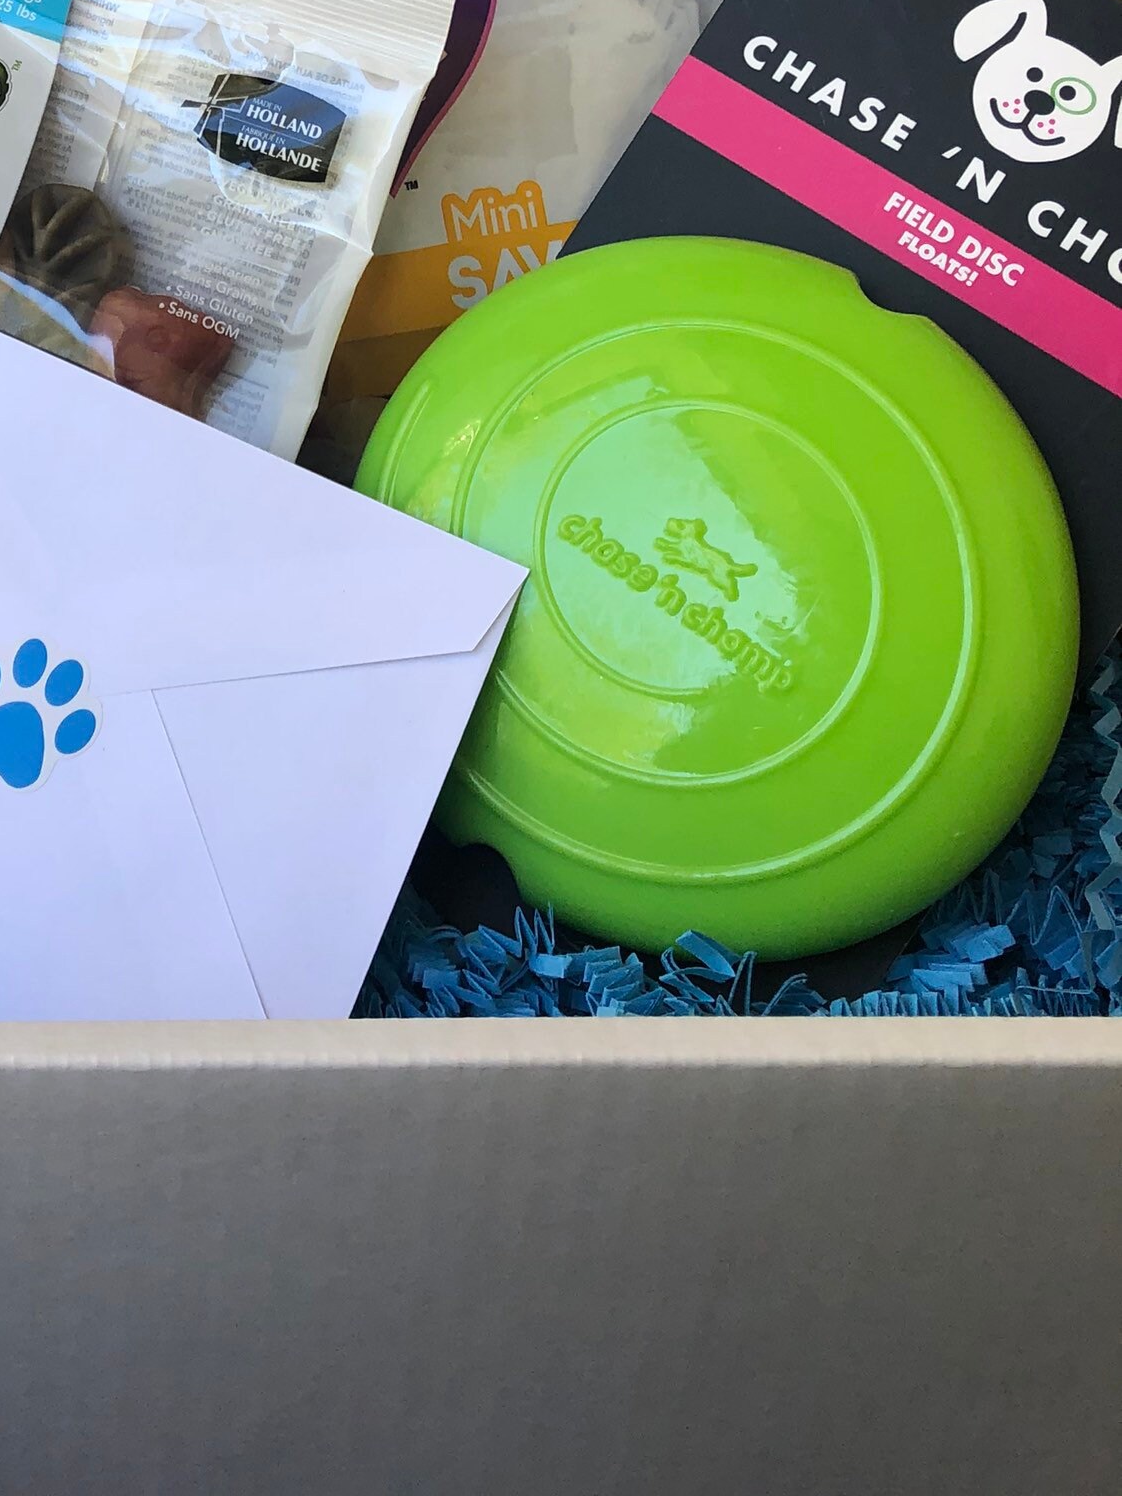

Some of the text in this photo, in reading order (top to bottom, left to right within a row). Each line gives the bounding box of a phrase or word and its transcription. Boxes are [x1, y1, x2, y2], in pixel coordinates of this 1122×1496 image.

[15, 4, 38, 22] lbs
[252, 98, 283, 112] MADE IN
[743, 35, 917, 152] CHASE
[246, 104, 323, 139] HOLLAND
[235, 132, 323, 172] HOLLANDE
[451, 189, 539, 242] Mini
[883, 191, 1025, 287] FIELD DISC
[898, 230, 979, 287] FLOATS!
[167, 301, 240, 340] Sans OGM
[175, 285, 254, 324] Sans Gluten
